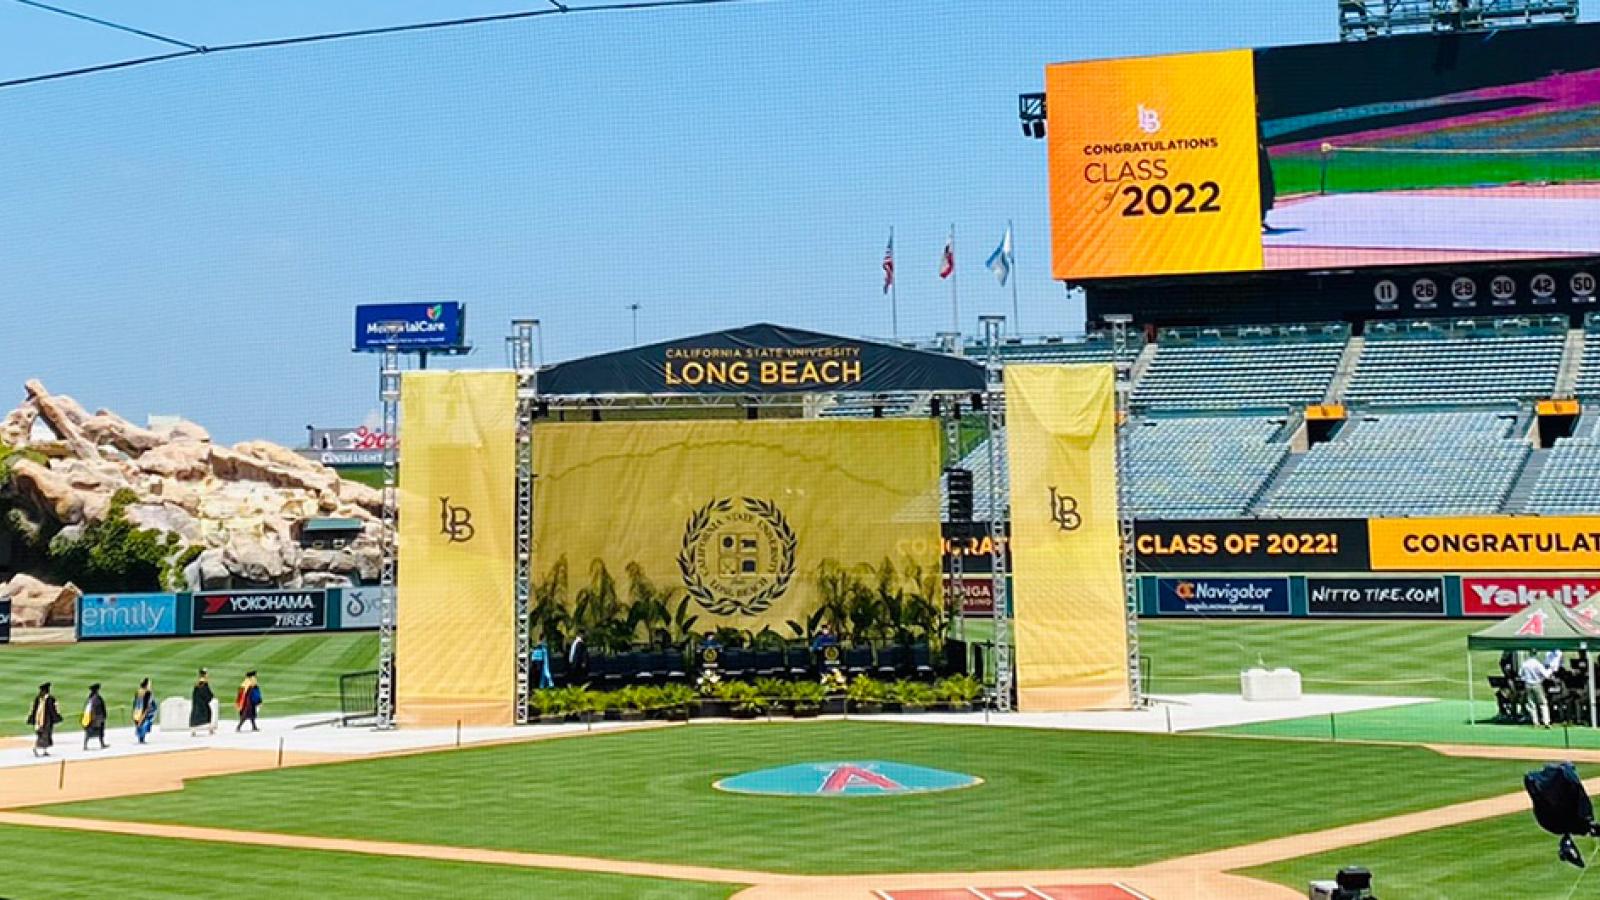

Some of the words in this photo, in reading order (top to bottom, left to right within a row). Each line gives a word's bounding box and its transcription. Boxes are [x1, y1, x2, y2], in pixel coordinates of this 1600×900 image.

[1083, 137, 1218, 156] CONGRATULATIONS
[1084, 158, 1168, 184] CLASS
[1122, 181, 1221, 217] 2022
[1380, 285, 1393, 298] 11
[1415, 283, 1434, 298] 26
[1493, 280, 1512, 295] 30
[1533, 278, 1553, 293] 42
[1573, 276, 1593, 291] 50
[366, 320, 445, 334] MeialCare
[665, 347, 741, 359] CALIFORNIA
[745, 347, 783, 358] STATE
[787, 346, 860, 358] UNIVERSITY
[664, 361, 750, 385] LONG
[760, 360, 862, 384] BEACH
[1047, 486, 1082, 531] LB
[439, 496, 475, 544] LB
[1137, 534, 1218, 554] CLASS
[1224, 534, 1260, 554] OF
[1266, 534, 1339, 554] 2022!
[1196, 582, 1273, 604] Navigator
[1312, 586, 1361, 603] NITTO
[1364, 586, 1441, 604] TIRE.COM
[230, 594, 313, 611] YOKOHAMA
[274, 612, 314, 627] TIRES
